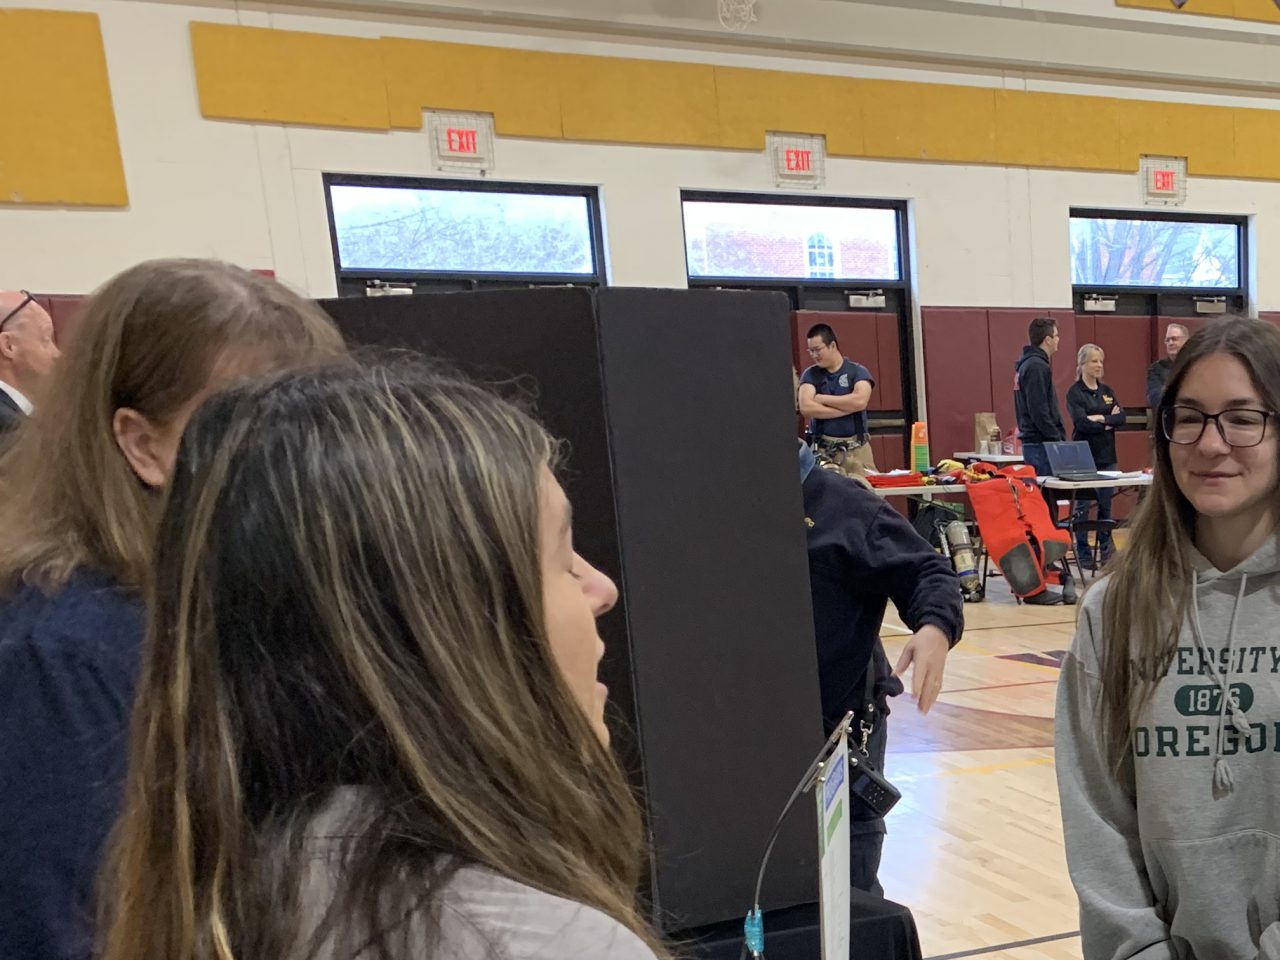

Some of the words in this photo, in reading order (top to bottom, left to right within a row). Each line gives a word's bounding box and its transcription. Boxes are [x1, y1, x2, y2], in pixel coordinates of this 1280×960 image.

[446, 127, 477, 153] EXIT
[784, 148, 812, 171] EXIT
[1153, 170, 1176, 191] EXIT
